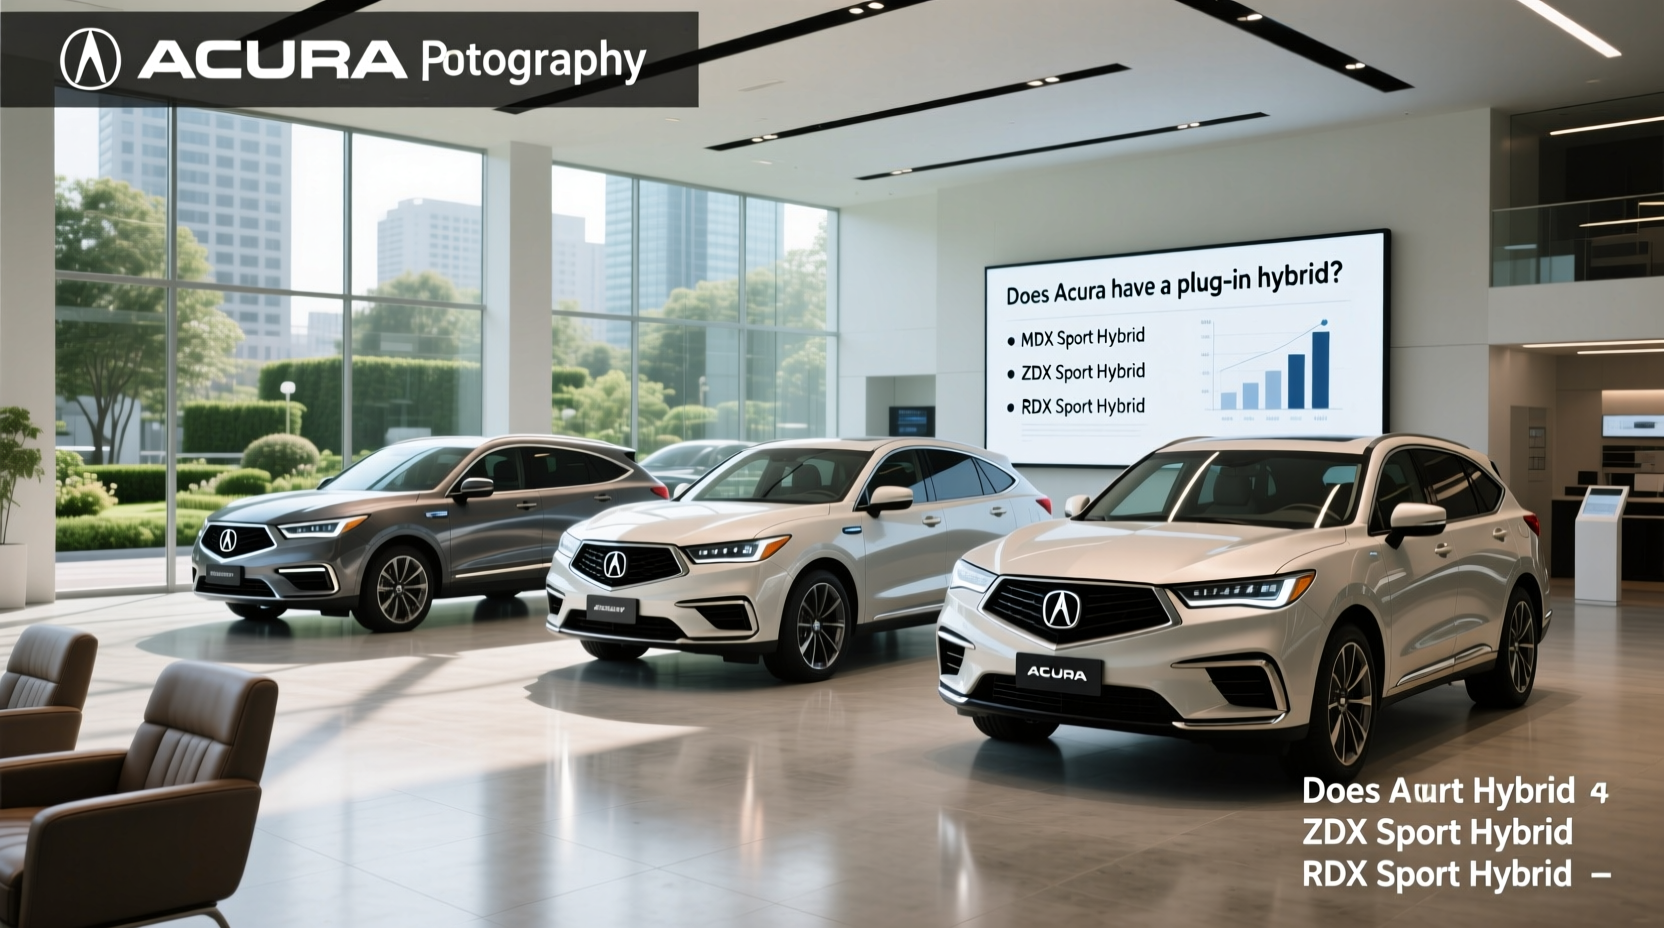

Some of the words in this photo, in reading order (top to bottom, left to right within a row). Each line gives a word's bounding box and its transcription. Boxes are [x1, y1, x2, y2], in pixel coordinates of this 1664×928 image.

[1007, 286, 1050, 306] Does
[1053, 282, 1106, 303] Acura
[1111, 277, 1156, 299] have
[1160, 279, 1171, 296] a
[1177, 268, 1251, 300] plug-in
[1258, 259, 1343, 294] hybrid?
[1021, 330, 1054, 348] MDX
[1056, 329, 1094, 351] Sport
[1097, 325, 1145, 348] Hybrid
[1021, 364, 1052, 381] ZDX
[1055, 364, 1094, 384] Sport
[1097, 361, 1146, 383] Hybrid
[1021, 398, 1052, 415] RDX
[1055, 397, 1093, 418] Sport
[1096, 396, 1146, 418] Hybrid
[1027, 666, 1087, 682] ACURA
